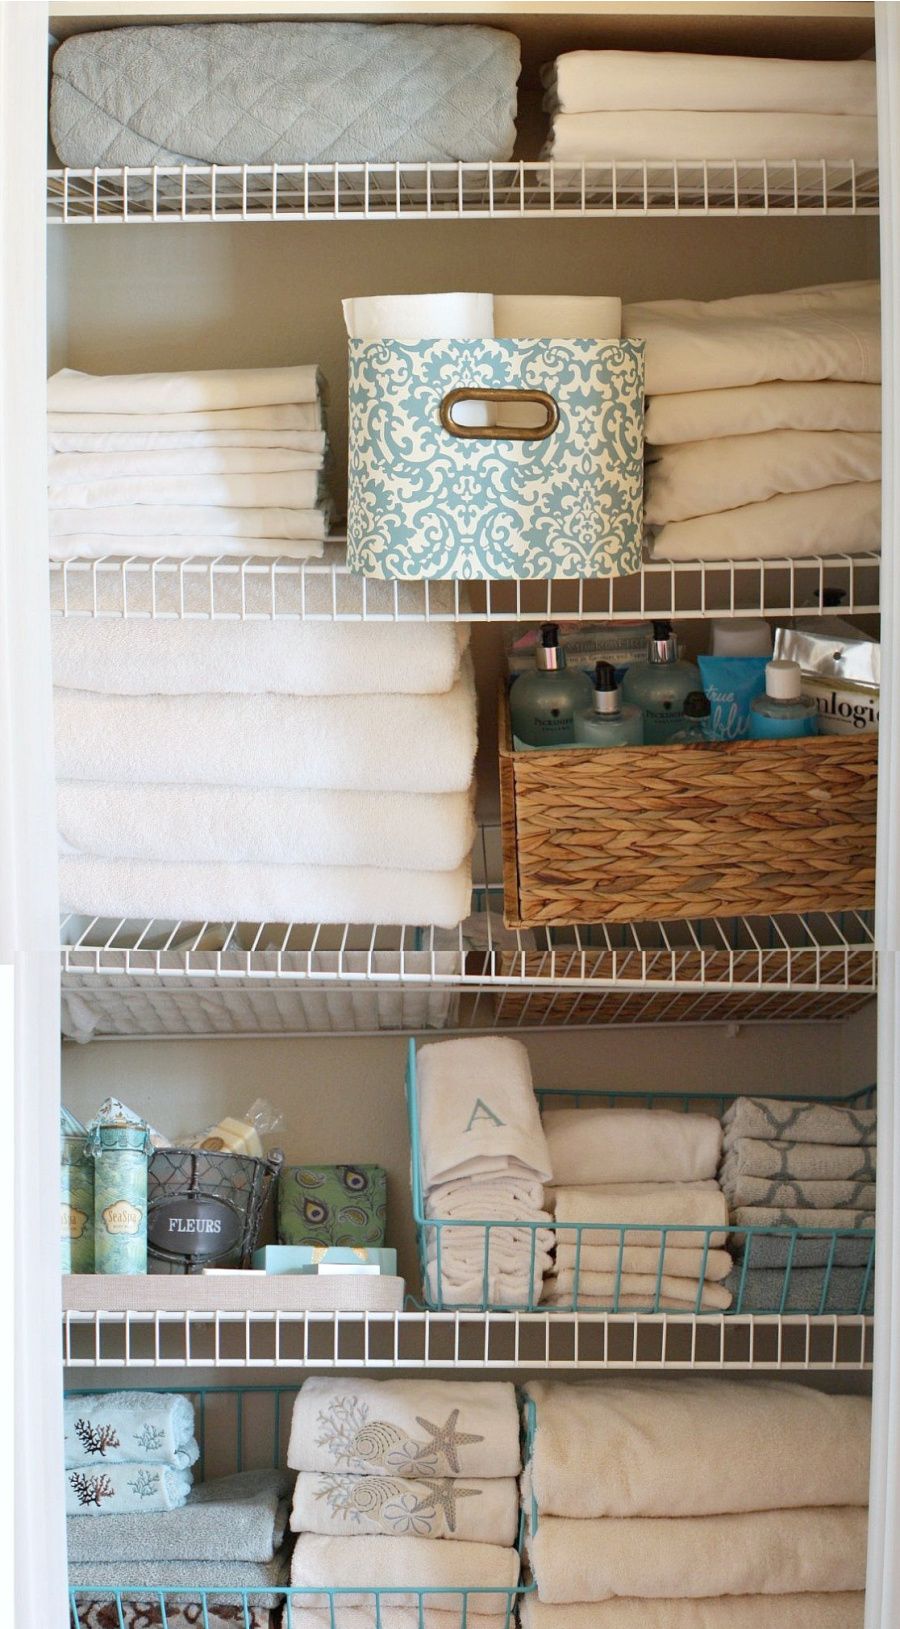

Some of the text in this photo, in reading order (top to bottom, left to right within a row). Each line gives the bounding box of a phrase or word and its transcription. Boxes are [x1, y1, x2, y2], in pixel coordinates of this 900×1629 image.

[705, 684, 735, 702] true
[702, 702, 752, 740] blu
[814, 691, 880, 729] nlogi
[462, 1098, 507, 1133] A
[108, 1210, 137, 1224] SeaSpa
[168, 1218, 222, 1233] FLEURS
